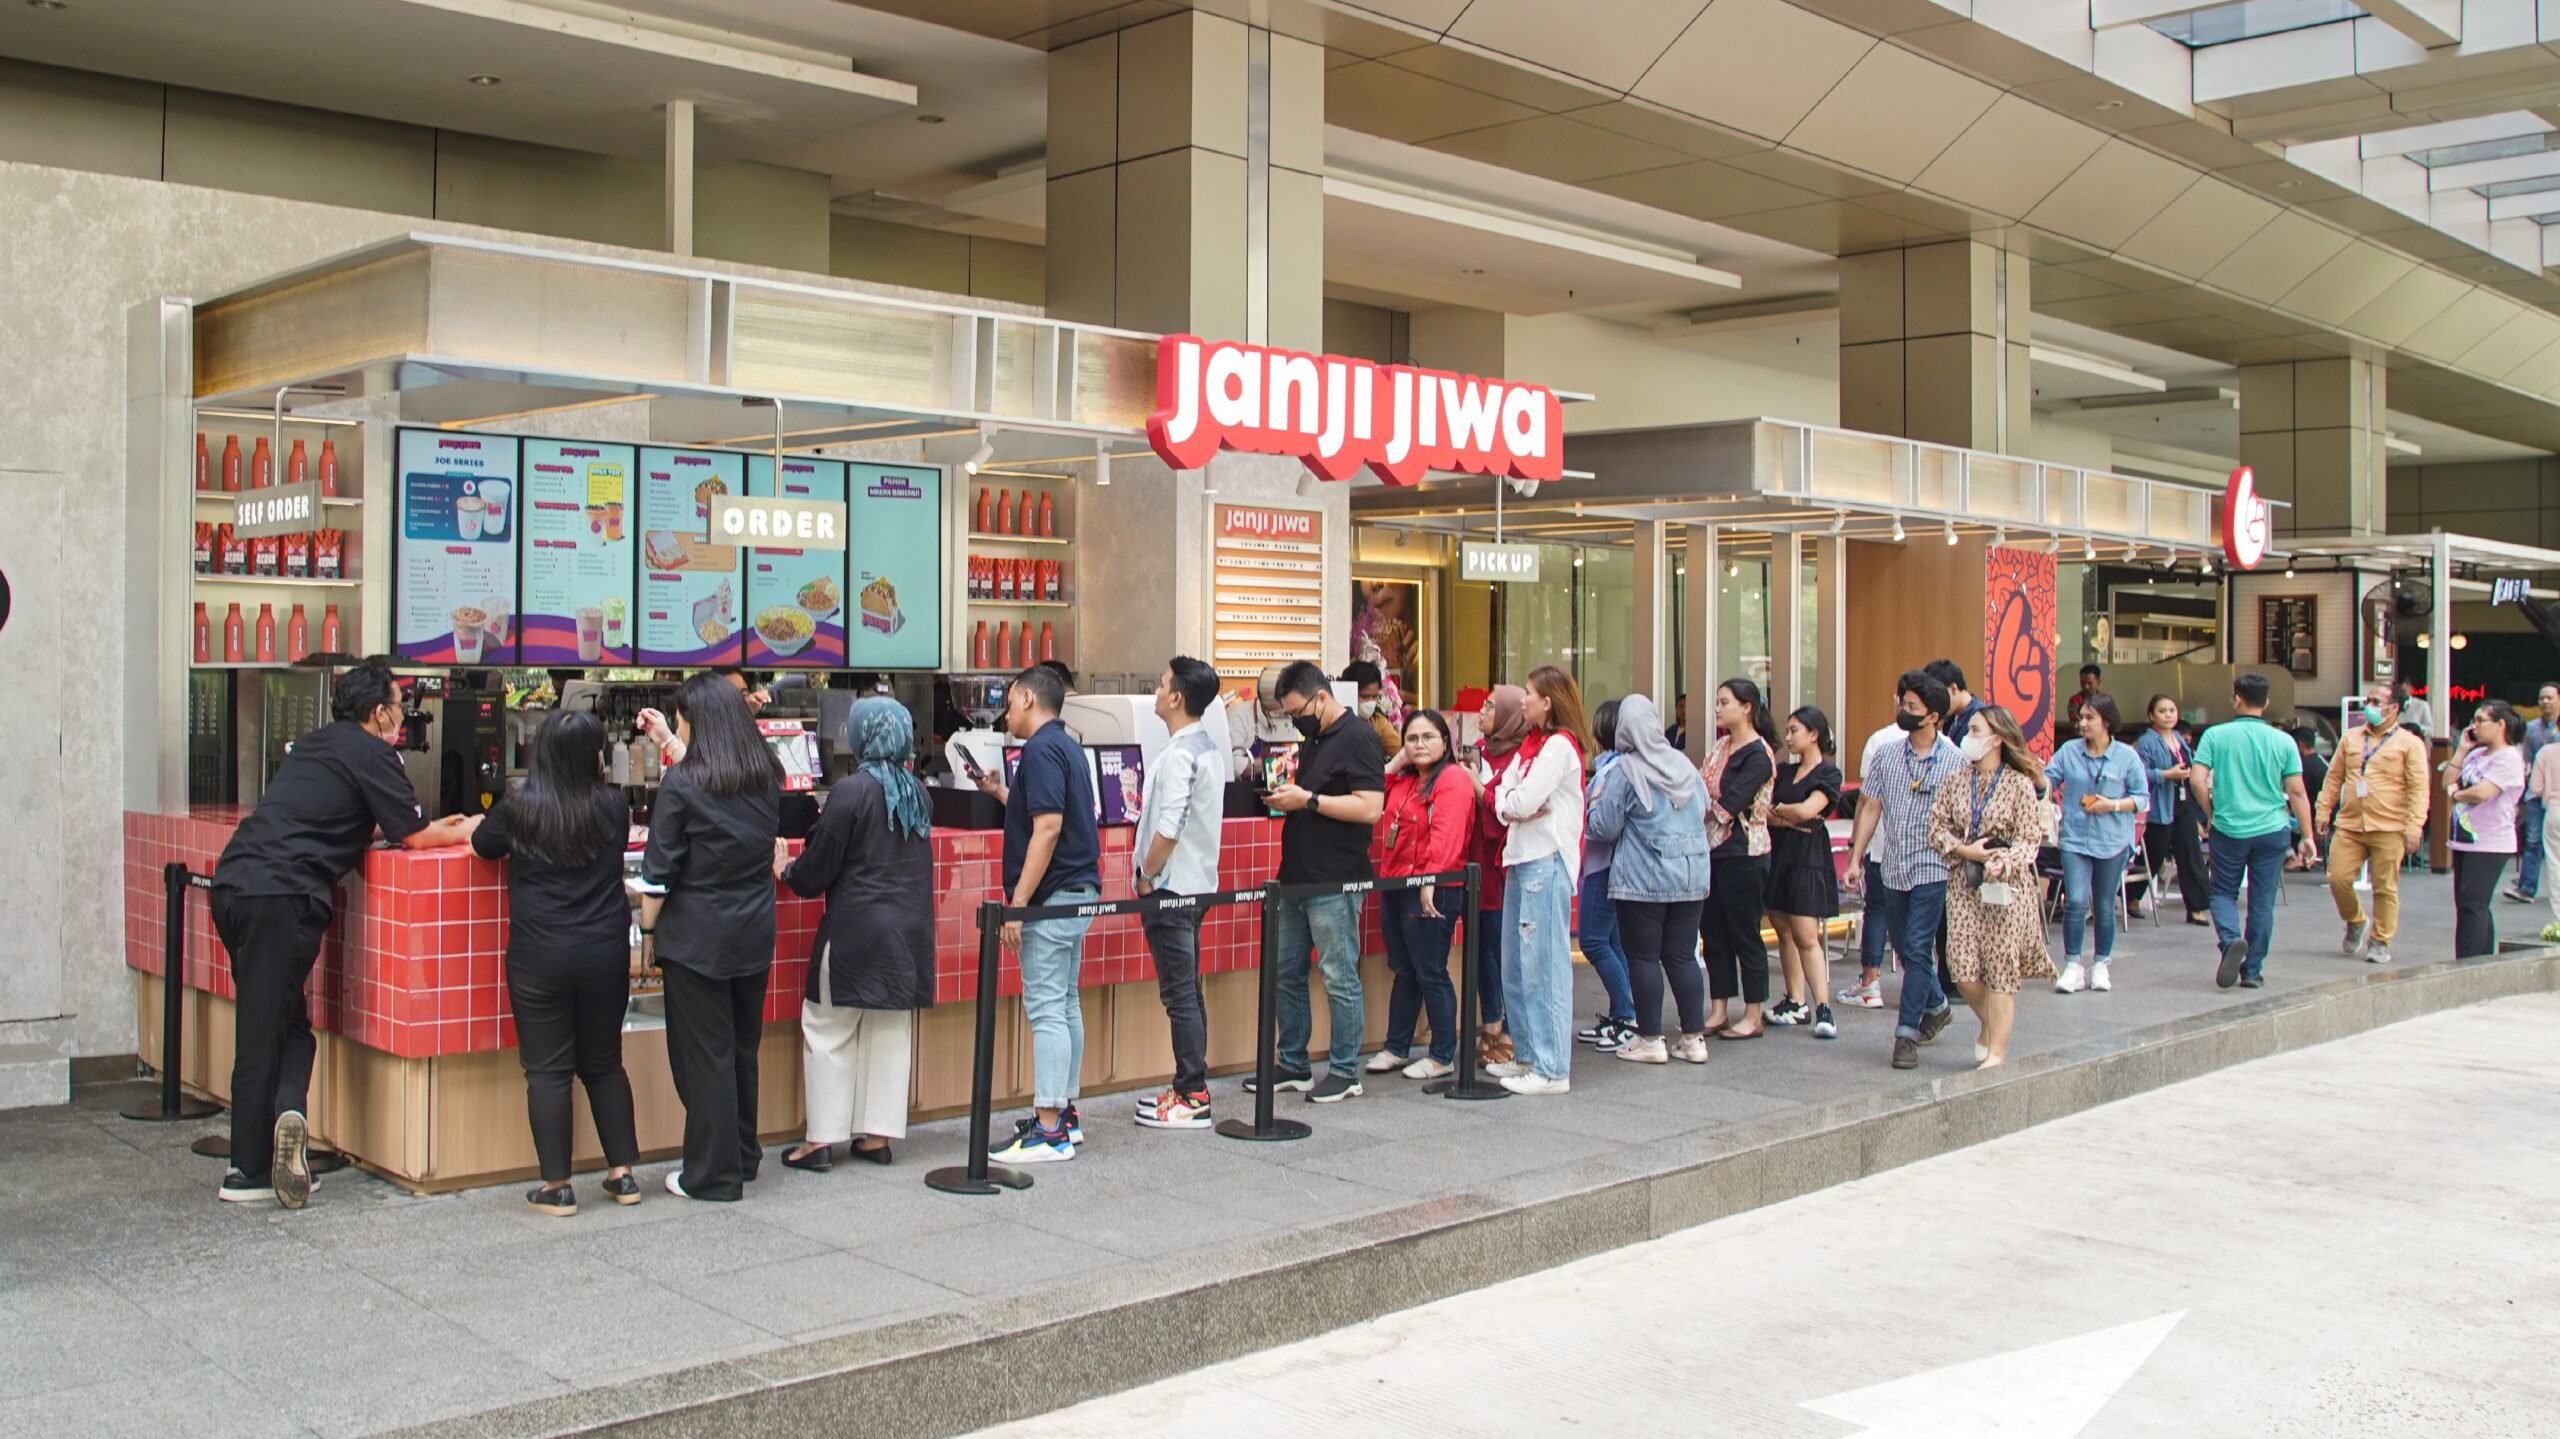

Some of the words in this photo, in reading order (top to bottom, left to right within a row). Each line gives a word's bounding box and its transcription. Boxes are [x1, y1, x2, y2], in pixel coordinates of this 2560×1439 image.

[434, 456, 451, 465] JOE
[453, 457, 484, 468] SERIES
[238, 501, 264, 526] SELF
[267, 495, 309, 523] ORDER
[723, 507, 835, 539] ORDER
[1469, 551, 1507, 572] PICK
[1511, 552, 1533, 573] UP
